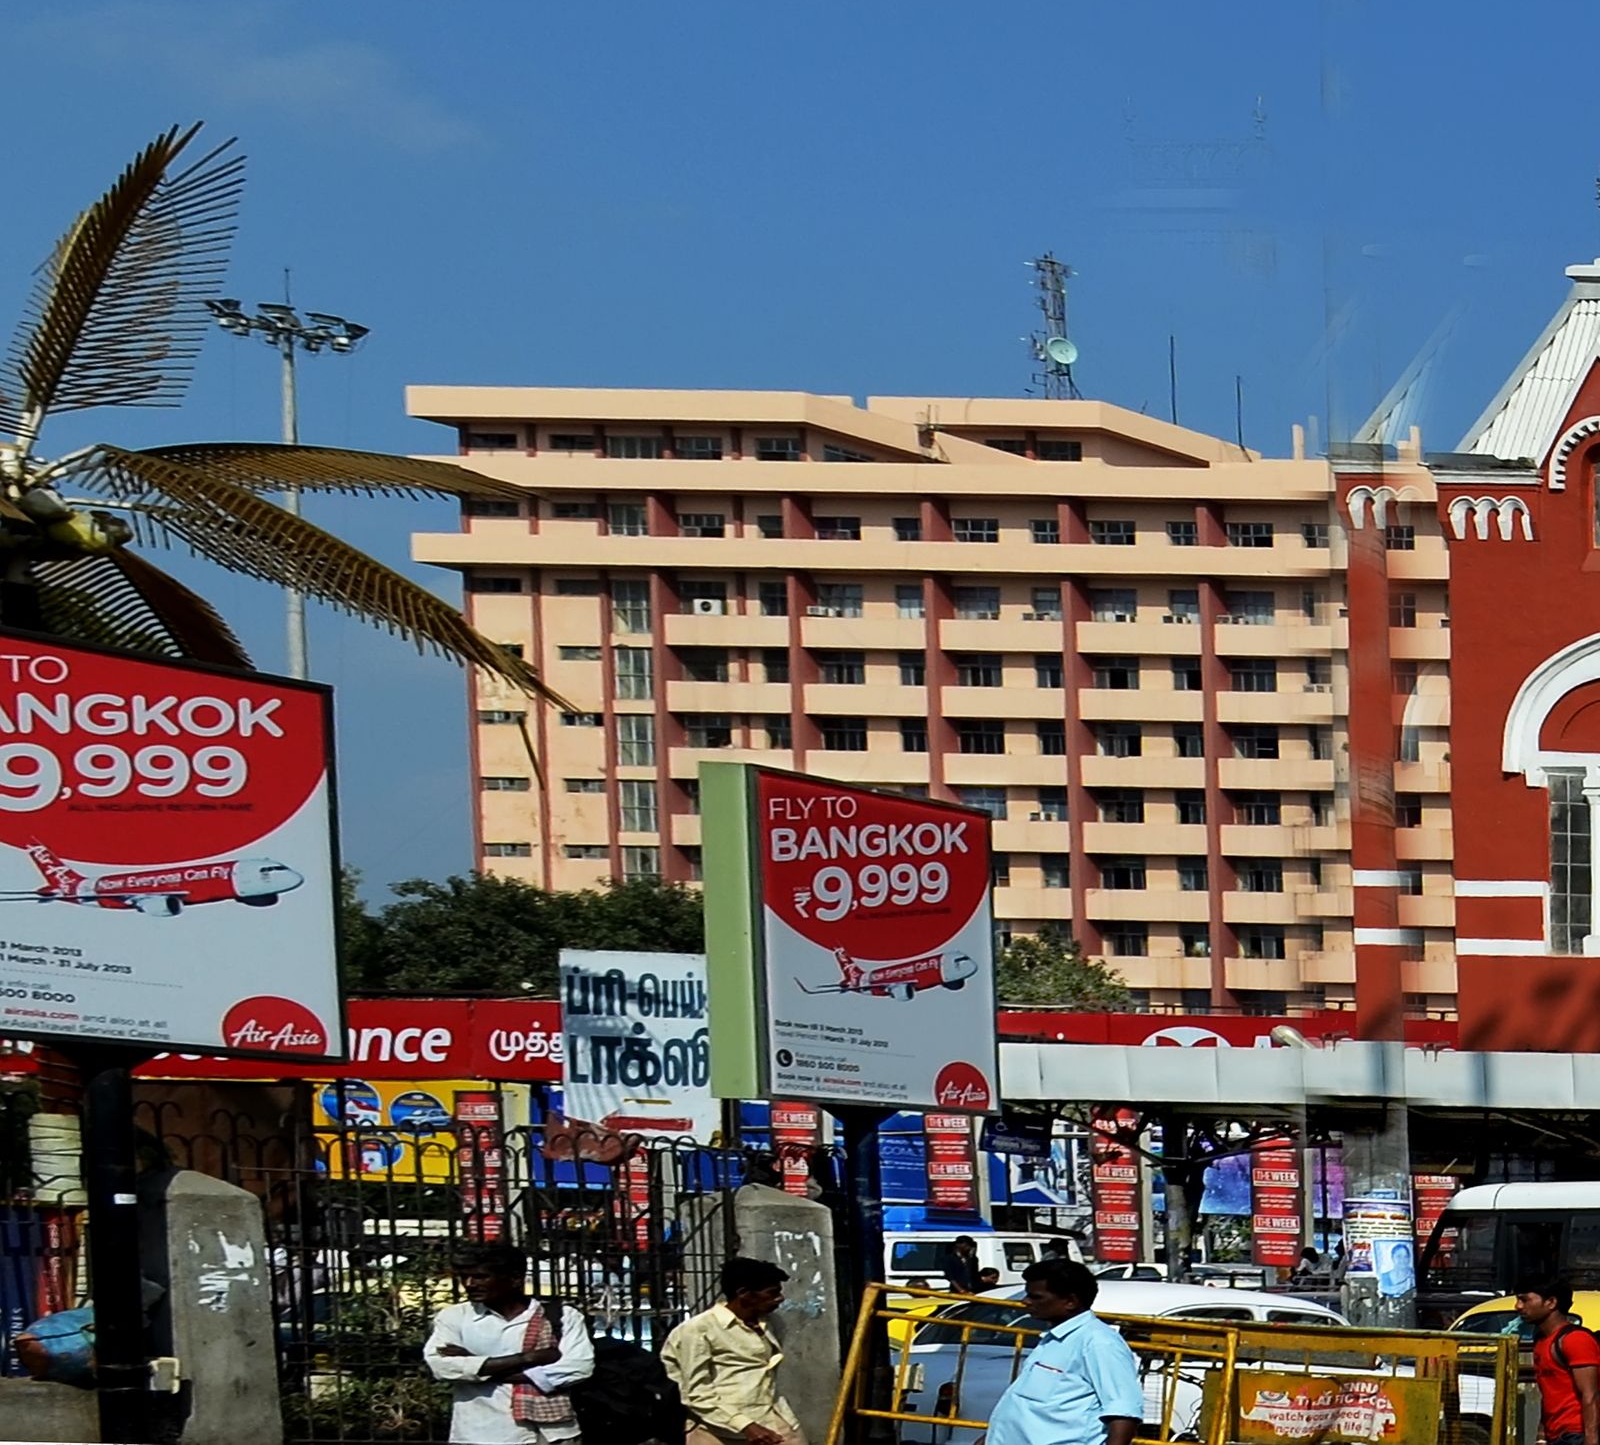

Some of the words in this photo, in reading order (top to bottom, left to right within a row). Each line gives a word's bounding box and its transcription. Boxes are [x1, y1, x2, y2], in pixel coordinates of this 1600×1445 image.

[1, 655, 69, 684] TO
[768, 797, 816, 821] FLY
[821, 796, 857, 819] TO
[770, 822, 969, 863] BANGKOK
[98, 877, 124, 890] Now
[128, 871, 180, 889] Everyone
[185, 868, 207, 882] Can
[211, 865, 231, 880] Fly
[10, 942, 49, 954] March
[53, 946, 82, 957] 2013
[8, 954, 47, 967] March
[73, 960, 99, 974] July
[102, 963, 132, 975] 2013
[4, 1007, 79, 1021] airasia.com
[82, 1011, 106, 1024] and
[109, 1014, 136, 1026] also
[79, 1023, 126, 1038] Service
[129, 1027, 171, 1041] Centre
[947, 1164, 972, 1176] WEEK
[1271, 1170, 1297, 1183] WEEK
[1272, 1217, 1298, 1230] WEEK
[1269, 1409, 1303, 1422] watch
